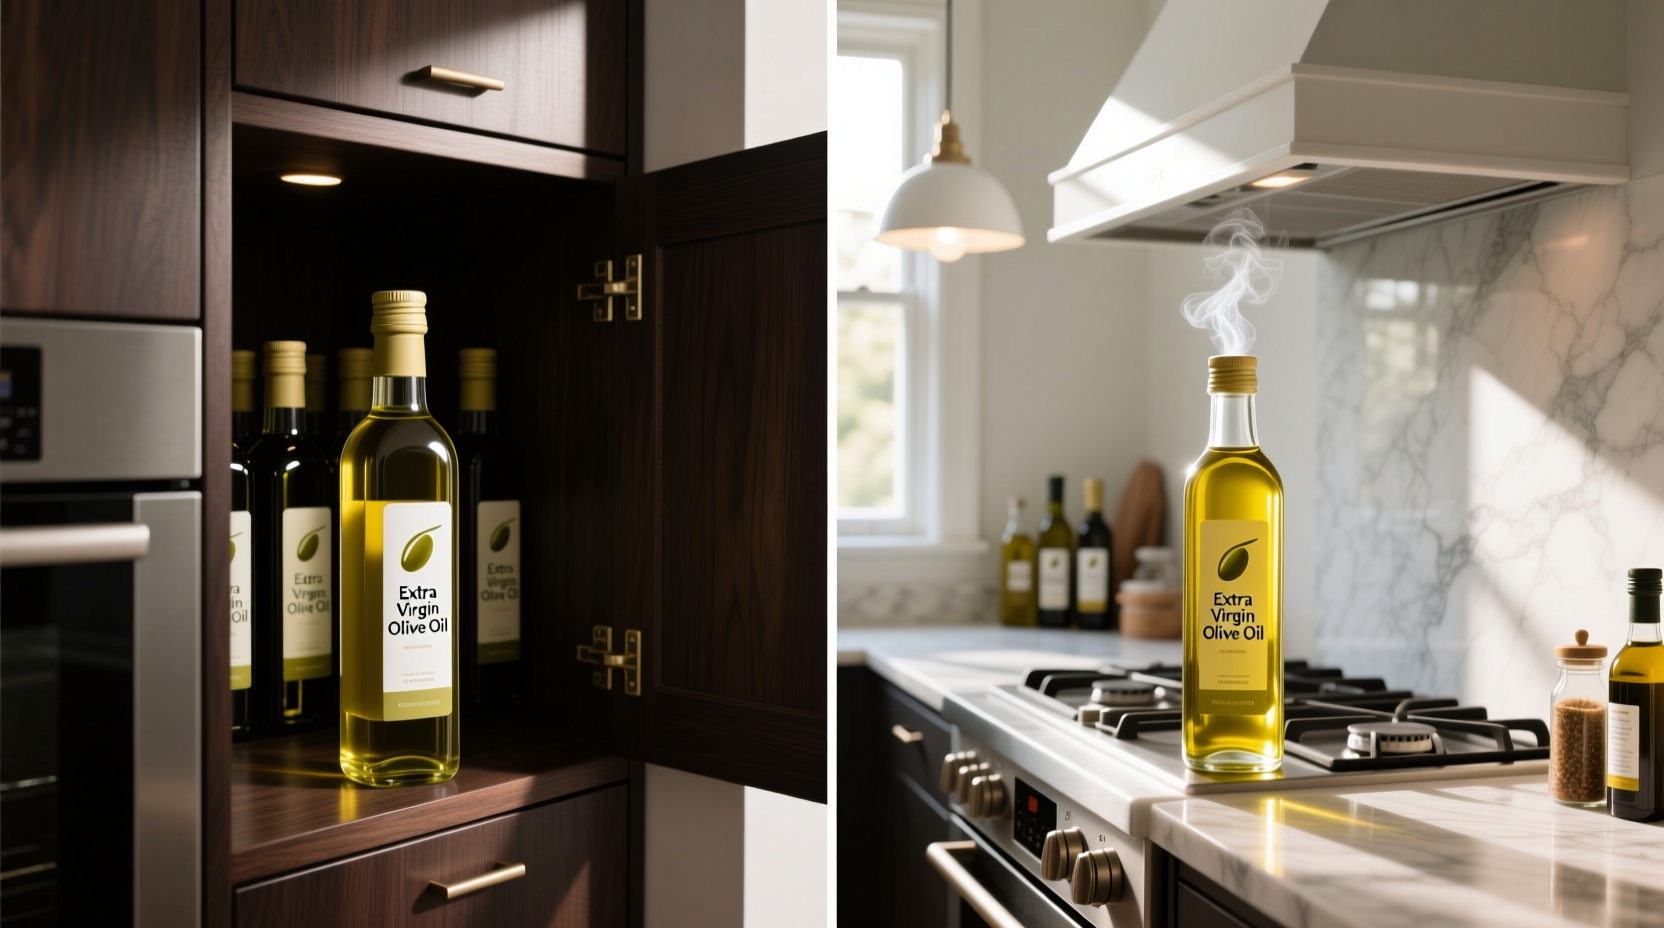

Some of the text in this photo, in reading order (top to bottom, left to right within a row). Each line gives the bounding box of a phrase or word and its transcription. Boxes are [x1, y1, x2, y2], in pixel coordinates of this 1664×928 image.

[294, 573, 323, 586] Extra
[399, 585, 437, 600] Extra
[1214, 592, 1252, 606] Extra
[231, 610, 248, 623] Oil
[396, 601, 439, 620] Virgin
[1210, 608, 1255, 626] Virgin
[388, 617, 448, 636] Olive Oil
[1203, 625, 1264, 640] Olive Oil
